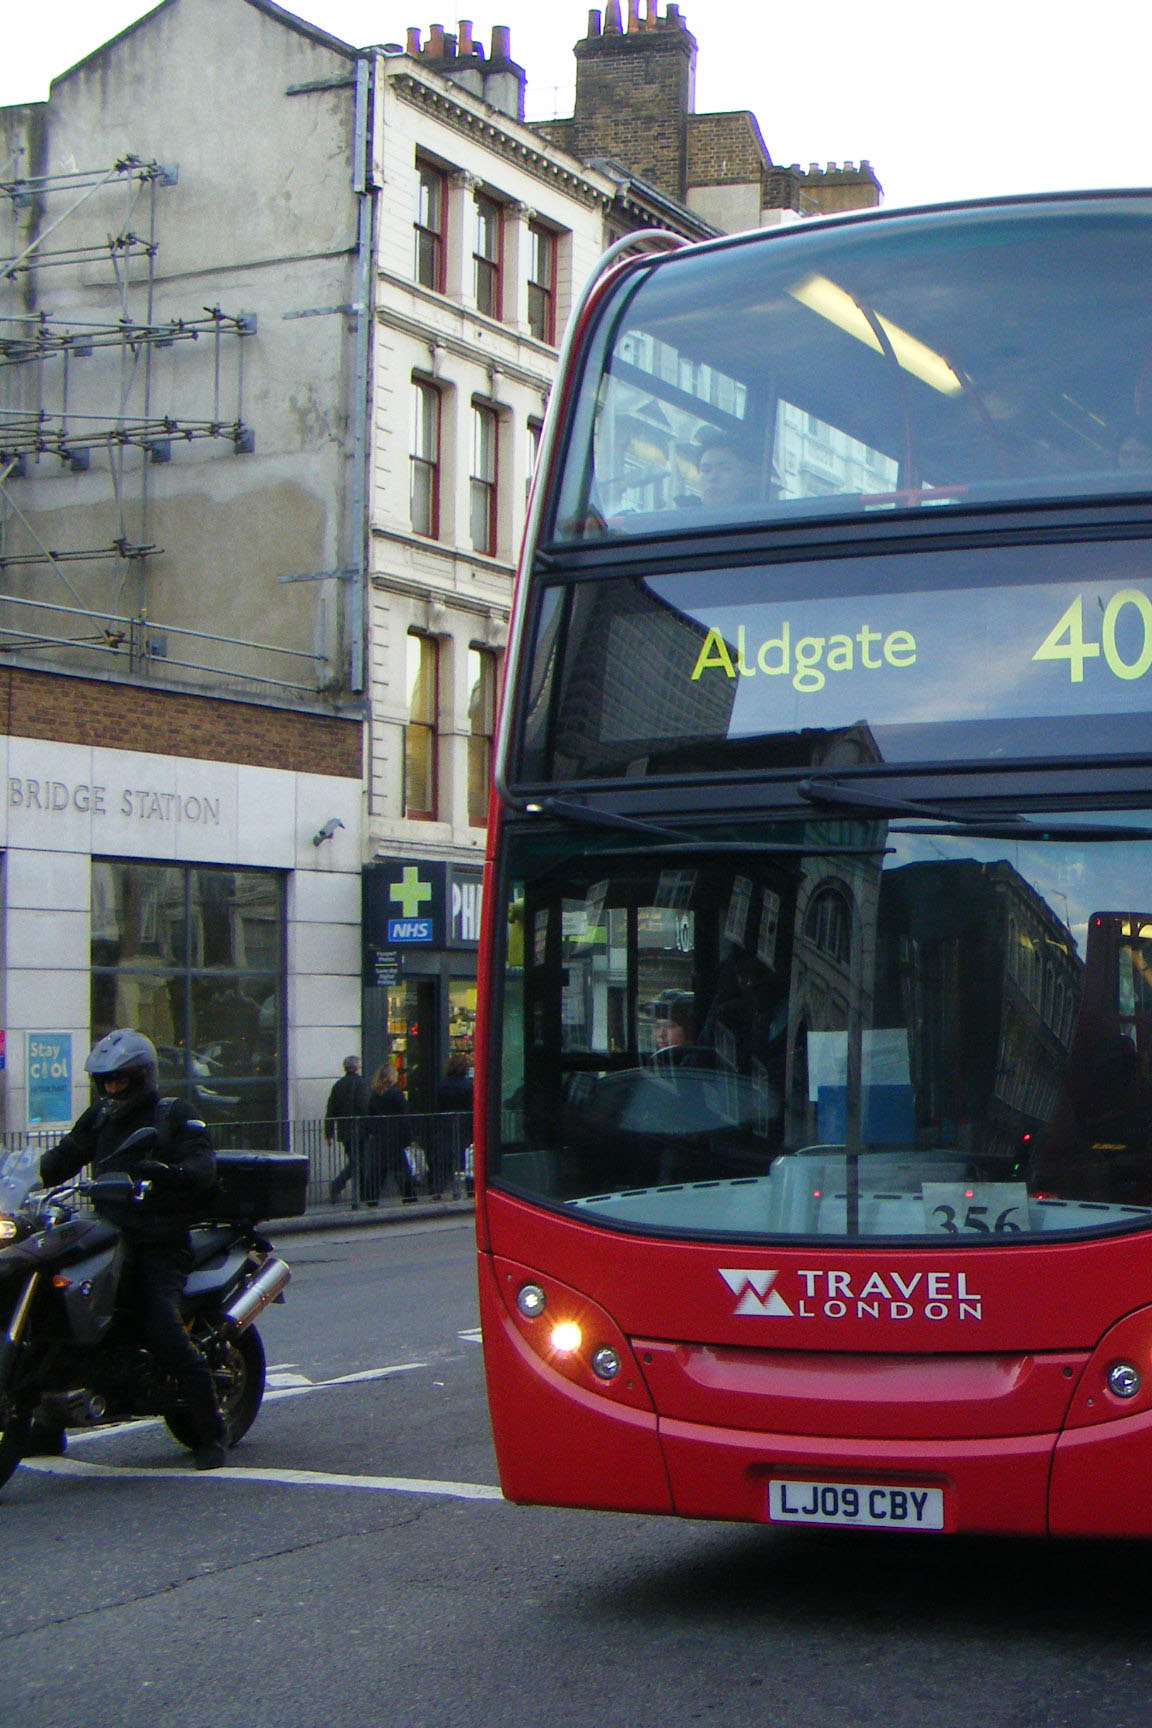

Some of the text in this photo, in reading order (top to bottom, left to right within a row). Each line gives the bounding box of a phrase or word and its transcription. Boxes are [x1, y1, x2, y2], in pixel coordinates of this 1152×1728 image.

[691, 621, 917, 693] Aldgate
[9, 777, 220, 826] BRIDGE STATION
[393, 922, 428, 938] NHS
[30, 1042, 60, 1060] Stay
[932, 1204, 1021, 1234] 356
[797, 1270, 982, 1300] TRAVEL
[799, 1300, 983, 1320] LONDON
[780, 1484, 929, 1522] LJ09 CBY
